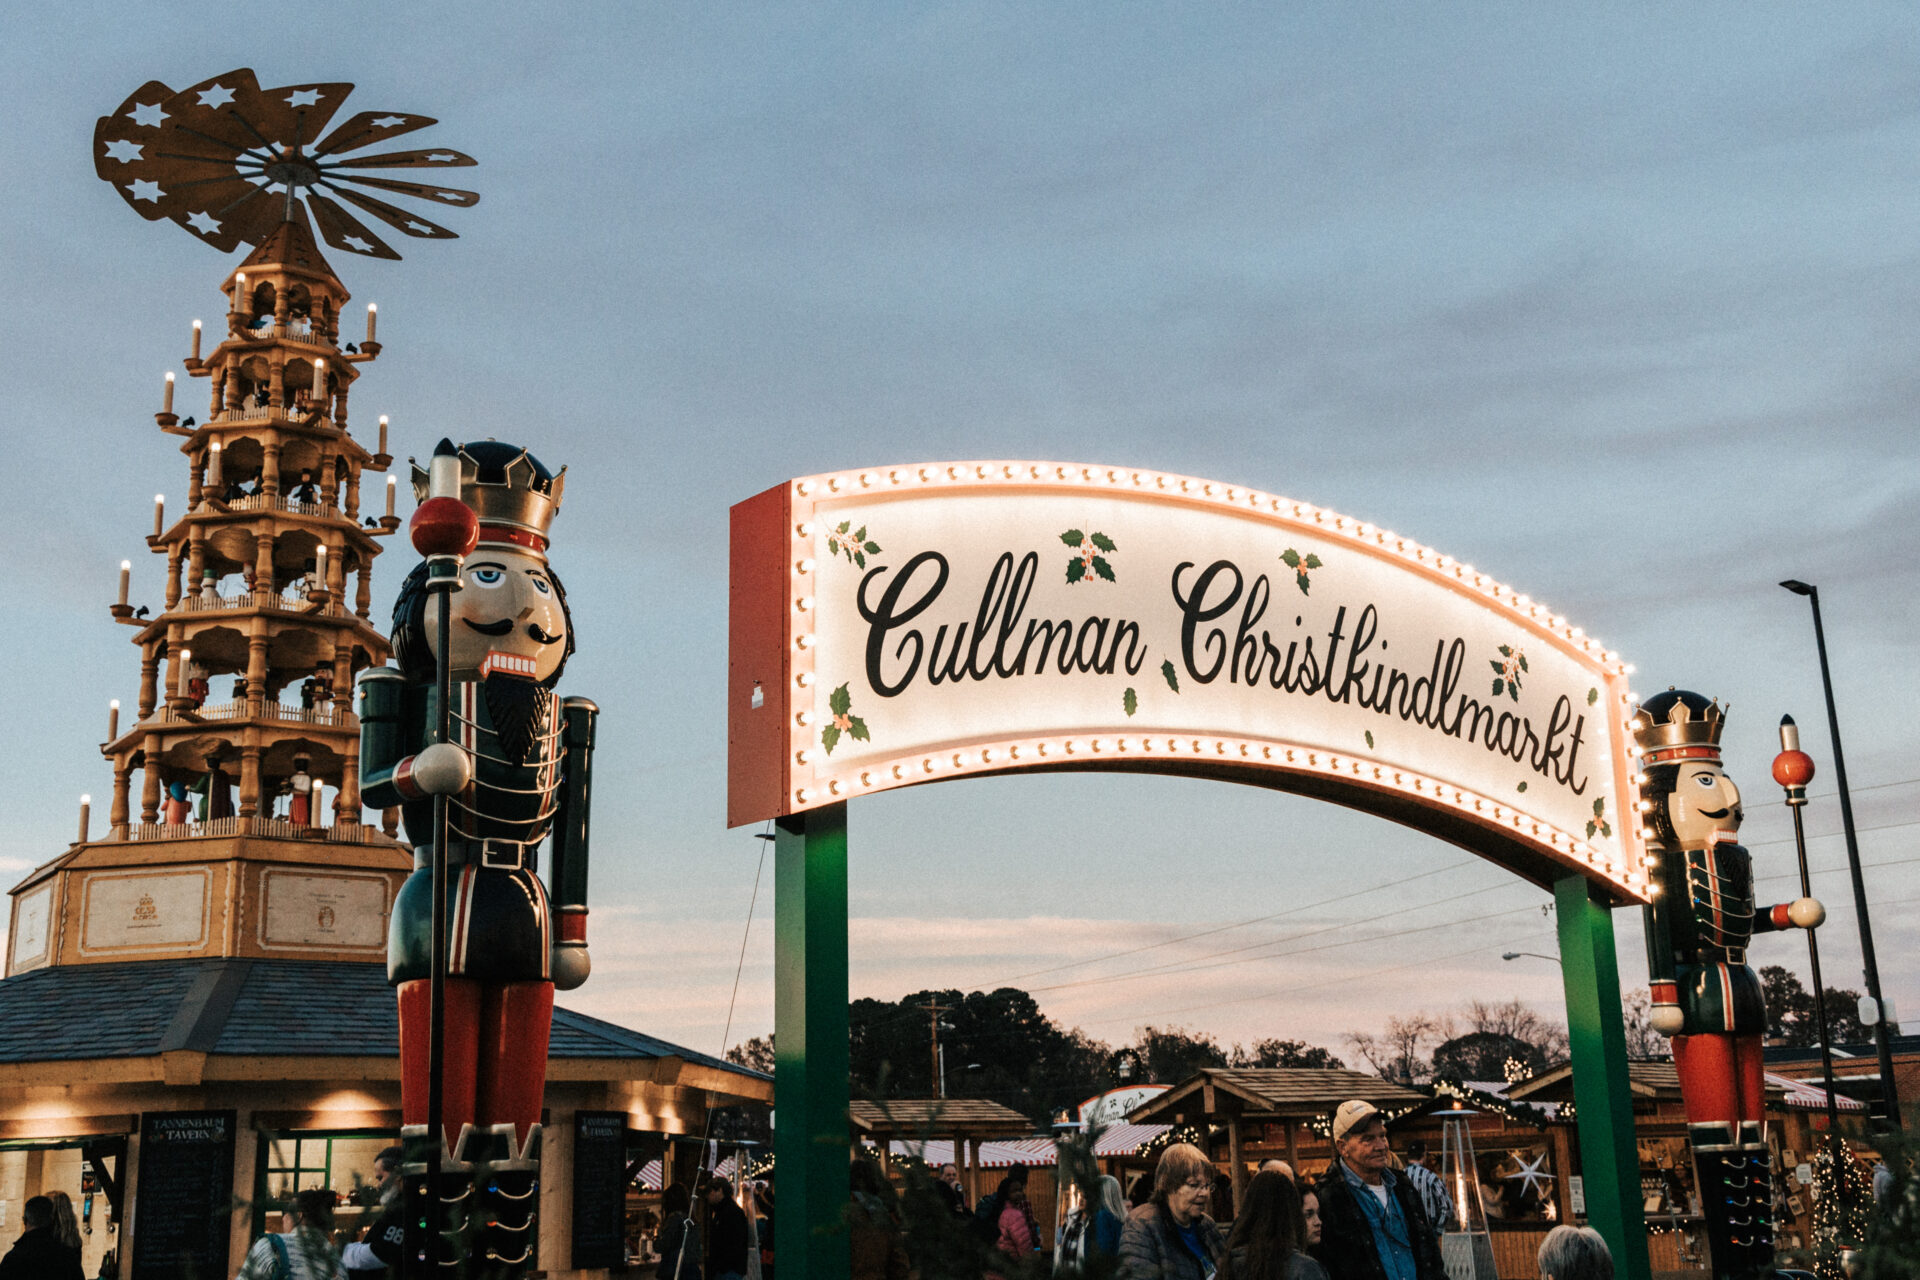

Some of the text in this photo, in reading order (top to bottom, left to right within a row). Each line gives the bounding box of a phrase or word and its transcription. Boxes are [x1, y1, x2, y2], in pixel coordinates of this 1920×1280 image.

[856, 551, 1588, 795] Cullman Christkindlmarkt
[166, 1130, 210, 1140] TAVERN
[383, 1225, 404, 1245] 98
